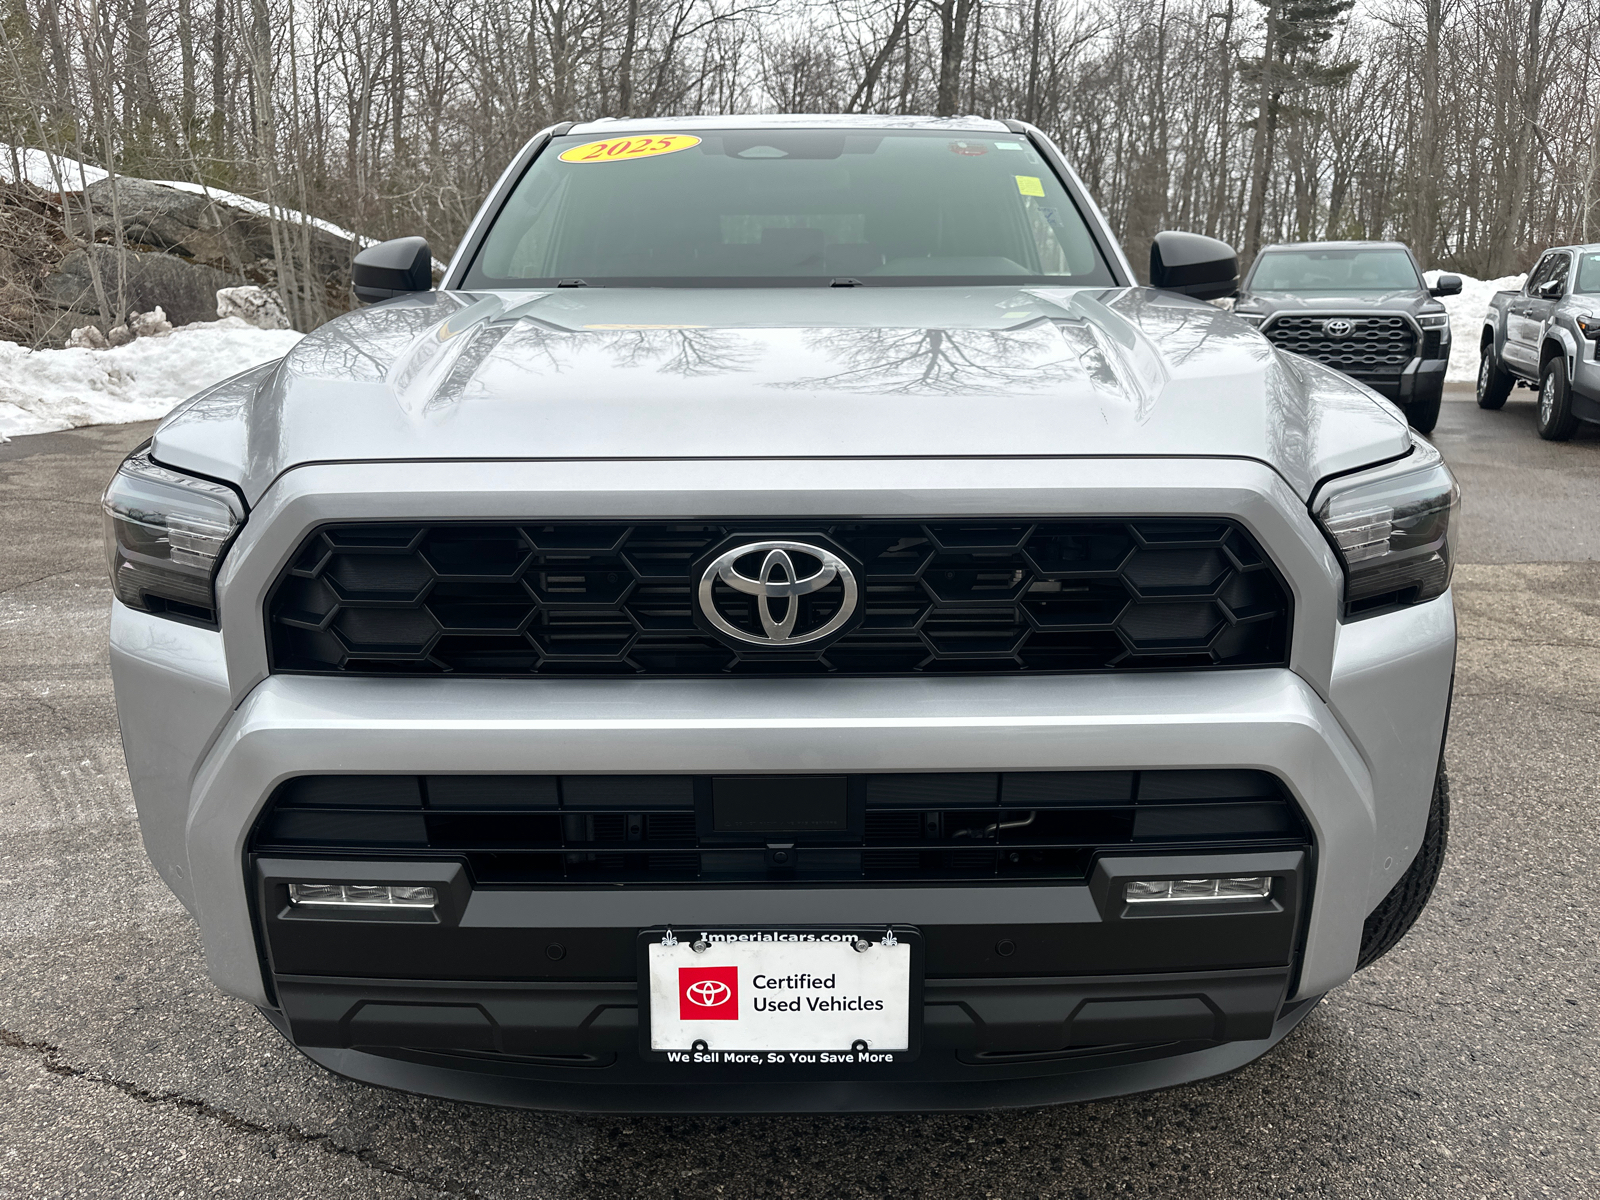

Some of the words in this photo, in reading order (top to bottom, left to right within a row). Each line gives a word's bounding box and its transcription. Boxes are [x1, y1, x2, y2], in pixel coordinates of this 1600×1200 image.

[582, 136, 677, 160] 2025
[700, 932, 859, 943] Imperialcars.com
[753, 973, 836, 989] Certified
[753, 996, 801, 1012] Used
[806, 996, 884, 1012] Vehicles
[667, 1052, 690, 1063] We
[694, 1052, 719, 1063] Sell
[724, 1052, 763, 1065] More,
[768, 1053, 785, 1063] So
[790, 1053, 816, 1063] You
[820, 1053, 854, 1063] Save
[859, 1053, 893, 1063] More
